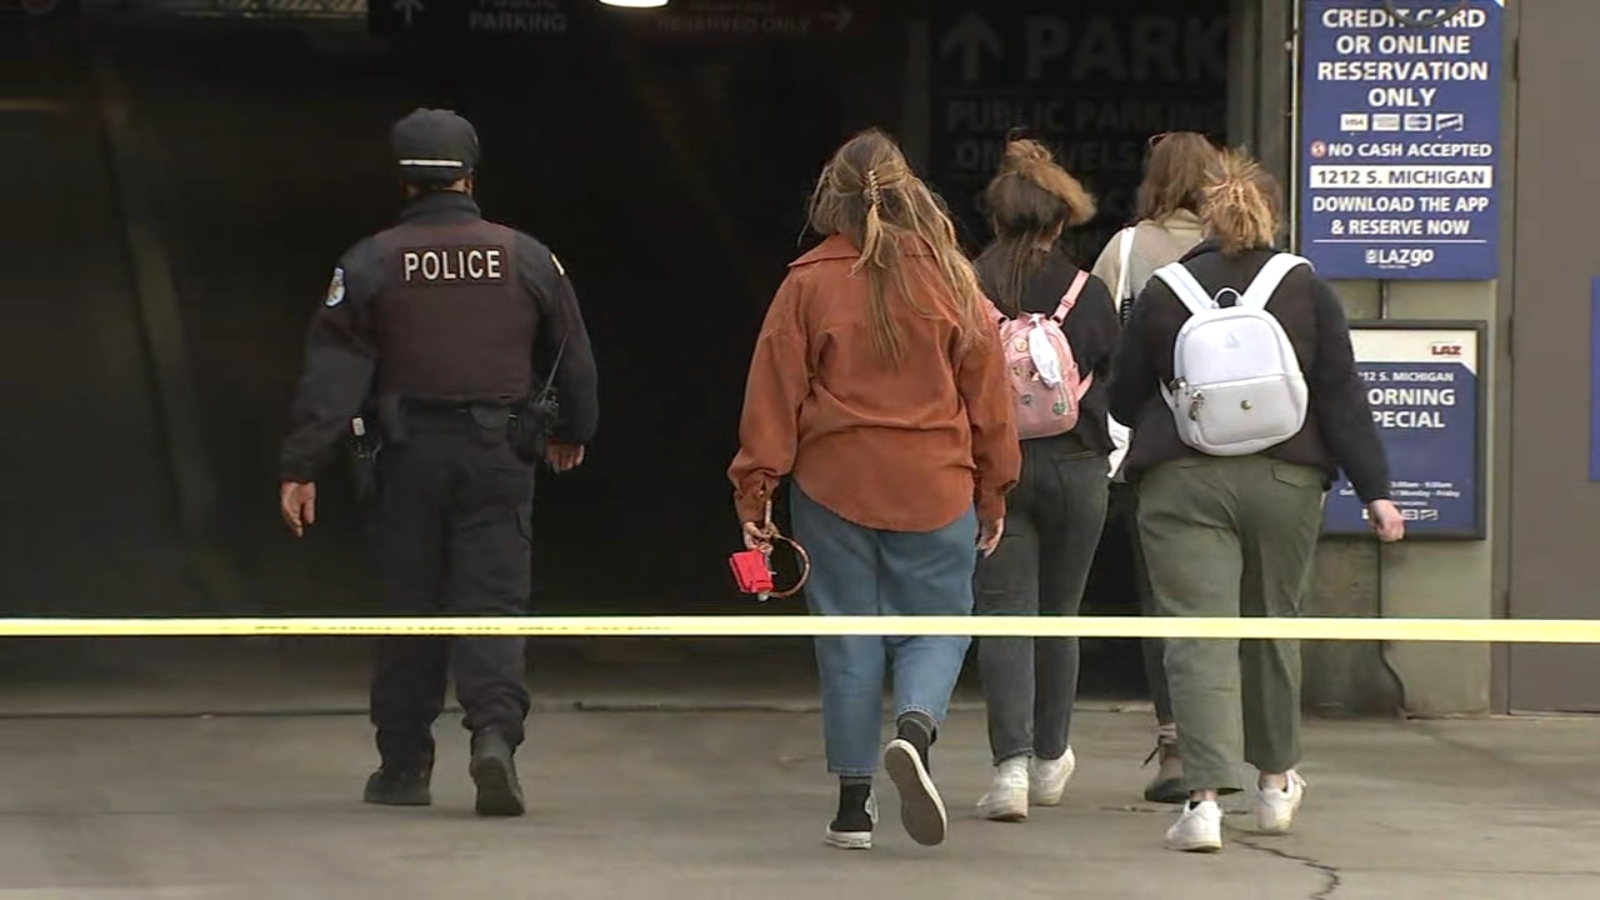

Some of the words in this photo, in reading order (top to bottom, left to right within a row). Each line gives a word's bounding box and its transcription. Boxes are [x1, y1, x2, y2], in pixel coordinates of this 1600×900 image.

[469, 11, 567, 32] PARKING
[1322, 8, 1410, 28] CREDIT
[1023, 13, 1228, 82] PARK
[1335, 35, 1371, 55] OR
[1378, 35, 1471, 55] ONLINE
[1317, 61, 1488, 81] RESERVATION
[1367, 87, 1437, 108] ONLY
[1328, 142, 1355, 157] NO
[1357, 142, 1404, 157] CASH
[1406, 142, 1493, 157] ACCEPTED
[1318, 170, 1360, 184] 1212
[1366, 170, 1383, 184] S.
[1388, 170, 1485, 184] MICHIGAN
[1313, 196, 1416, 212] DOWNLOAD
[1418, 196, 1451, 212] THE
[1454, 196, 1490, 212] APP
[1330, 219, 1345, 235] &
[1348, 219, 1424, 235] RESERVE
[1426, 219, 1471, 235] NOW
[404, 250, 501, 281] POLICE
[1431, 345, 1462, 356] LAZ
[1378, 371, 1390, 382] S.
[1392, 371, 1455, 382] MICHIGAN
[1367, 388, 1456, 406] ORNING
[1372, 410, 1446, 428] PECIAL
